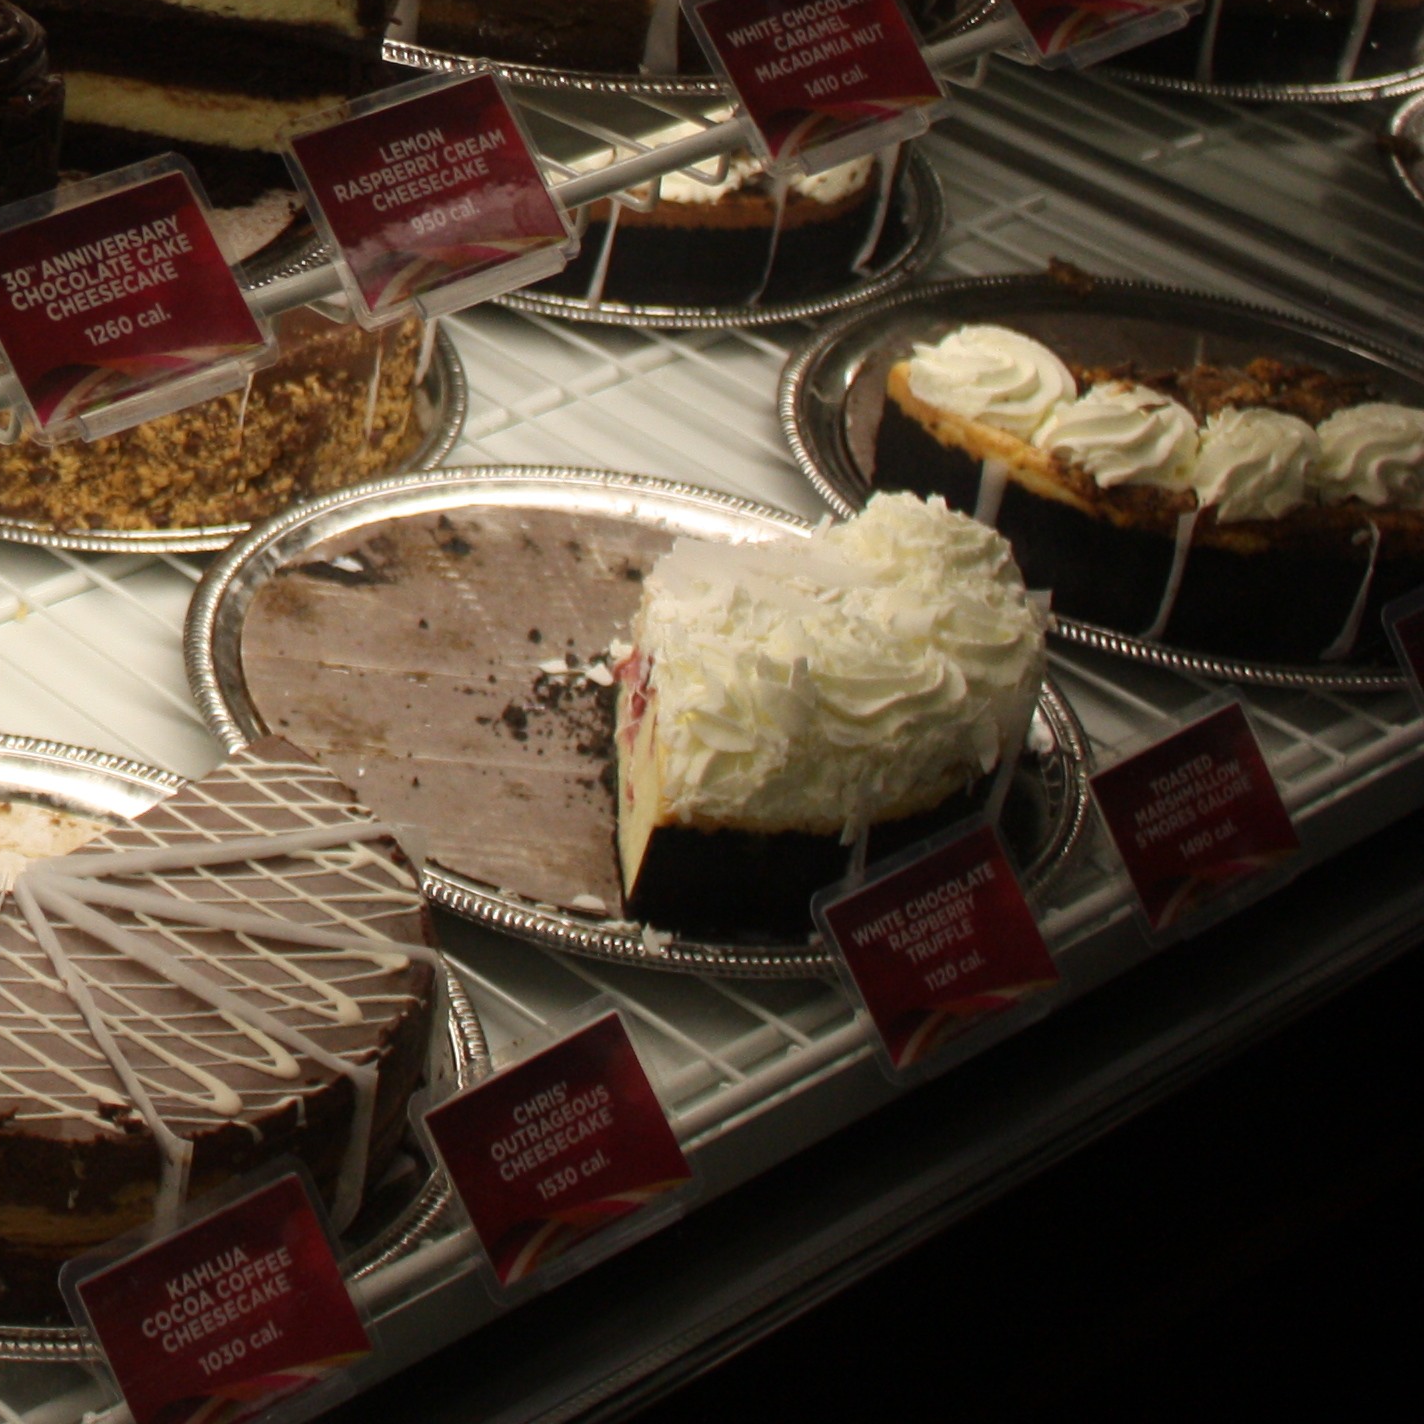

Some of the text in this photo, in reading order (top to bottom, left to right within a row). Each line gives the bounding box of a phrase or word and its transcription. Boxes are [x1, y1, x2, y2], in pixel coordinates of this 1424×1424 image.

[726, 19, 780, 47] WHITE
[755, 23, 884, 83] MACADAMIA NUT
[774, 15, 850, 52] CARAMEL
[804, 65, 868, 98] 1410 cal.
[334, 129, 506, 203] RASPBERRY CREAM
[379, 128, 443, 163] LEMON
[372, 157, 490, 212] CHEESECAKE
[411, 198, 480, 235] 950 cal.
[11, 231, 194, 312] CHOCOLATE CAKE
[41, 215, 180, 274] ANNIVERSARY
[45, 260, 179, 322] CHEESECAKE
[84, 302, 171, 347] 1260 cal.
[852, 861, 996, 947] WHITE CHOCOLATE
[888, 895, 976, 952] RASPBERRY
[905, 919, 975, 964] TRUFFLE
[924, 950, 986, 991] 1120 cal.
[491, 1085, 609, 1162] OUTRAGEOUS
[513, 1081, 567, 1124] CHRIS'
[500, 1107, 613, 1181] CHEESECAKE
[537, 1149, 610, 1201] 1530 cal.
[142, 1246, 292, 1338] COCOA COFFEE
[162, 1274, 292, 1353] CHEESECAKE
[199, 1322, 283, 1375] 1030 cal.
